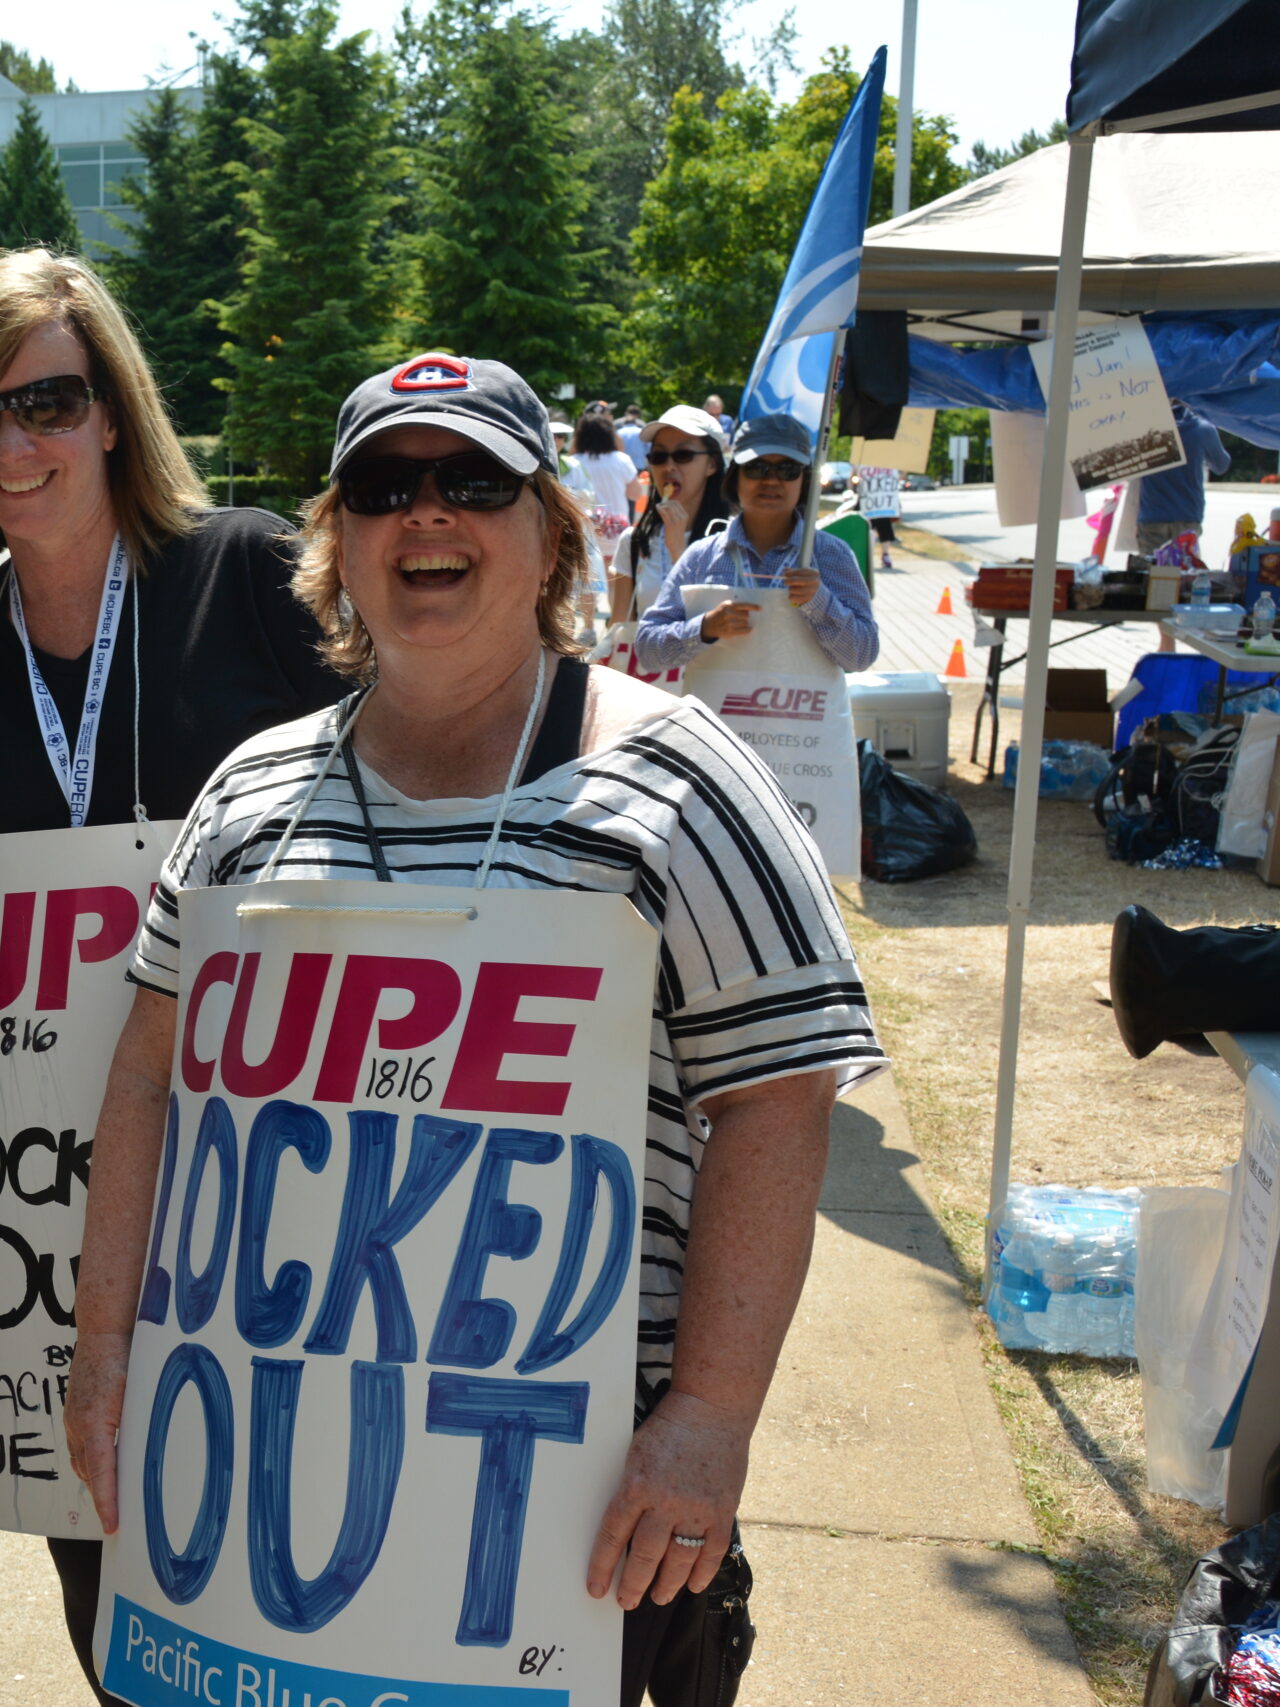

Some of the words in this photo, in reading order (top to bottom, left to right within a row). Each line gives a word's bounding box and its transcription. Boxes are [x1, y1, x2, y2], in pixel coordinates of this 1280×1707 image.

[865, 495, 894, 510] OUT
[101, 594, 116, 635] @CUPEBC
[94, 652, 106, 676] CUPE
[91, 677, 101, 691] BC
[750, 687, 828, 713] CUPE
[803, 735, 821, 748] OF
[793, 764, 833, 778] CROSS
[70, 758, 90, 826] CUPEBC
[180, 951, 604, 1116] CUPE
[365, 1056, 437, 1103] 1816
[136, 1090, 638, 1376] LOCKED
[142, 1343, 591, 1648] OUT
[124, 1613, 224, 1707] Pacific
[517, 1645, 566, 1677] BY:
